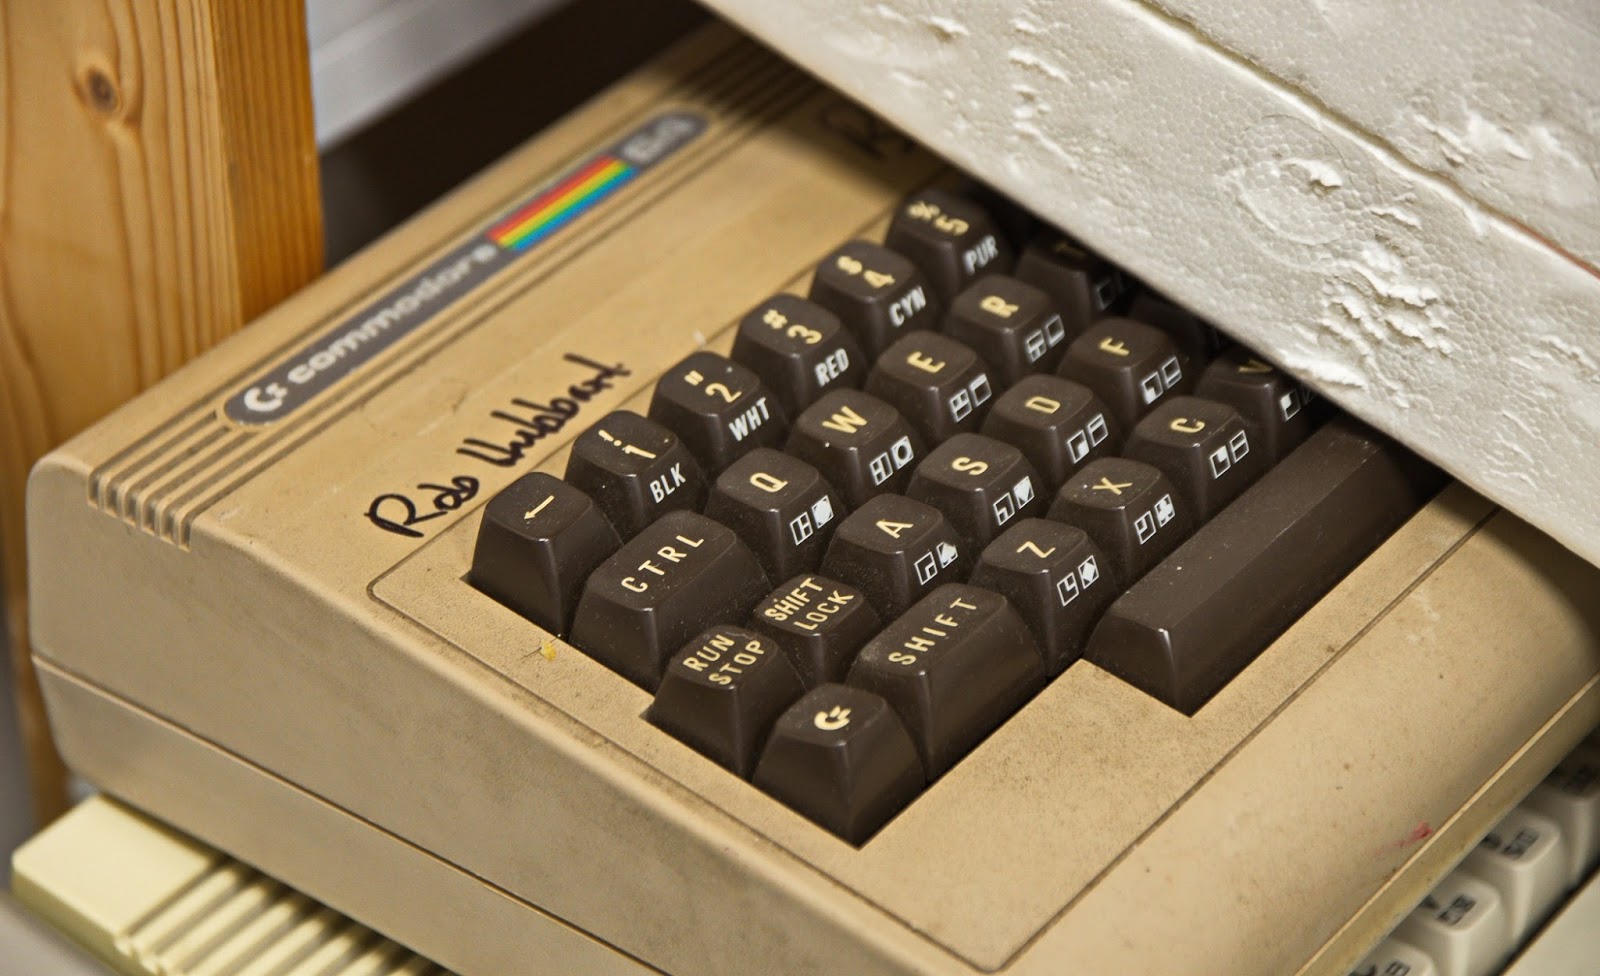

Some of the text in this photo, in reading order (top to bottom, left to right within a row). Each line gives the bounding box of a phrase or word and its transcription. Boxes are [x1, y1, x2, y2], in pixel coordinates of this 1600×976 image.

[934, 214, 970, 236] 5
[961, 234, 998, 275] PUR
[863, 269, 896, 289] 4
[287, 243, 498, 384] commodore
[888, 285, 926, 327] CYN
[980, 295, 1019, 318] R
[787, 324, 823, 345] 3
[1098, 336, 1130, 356] F
[814, 347, 850, 387] RED
[906, 351, 946, 373] E
[705, 382, 742, 403] 2
[1024, 396, 1061, 414] D
[728, 396, 770, 442] WHT
[822, 405, 868, 434] W
[1170, 417, 1206, 433] C
[622, 444, 656, 460] 1
[951, 456, 989, 476] S
[650, 462, 687, 504] BLK
[750, 472, 789, 493] Q
[1092, 477, 1133, 495] X
[364, 475, 480, 538] Rob
[875, 518, 914, 539] A
[1016, 541, 1056, 558] Z
[620, 534, 704, 593] CTRL
[764, 577, 823, 622] SHIFT
[794, 590, 855, 631] LOCK
[888, 597, 977, 666] SHIFT
[682, 634, 735, 672] RUN
[708, 639, 766, 686] STOP
